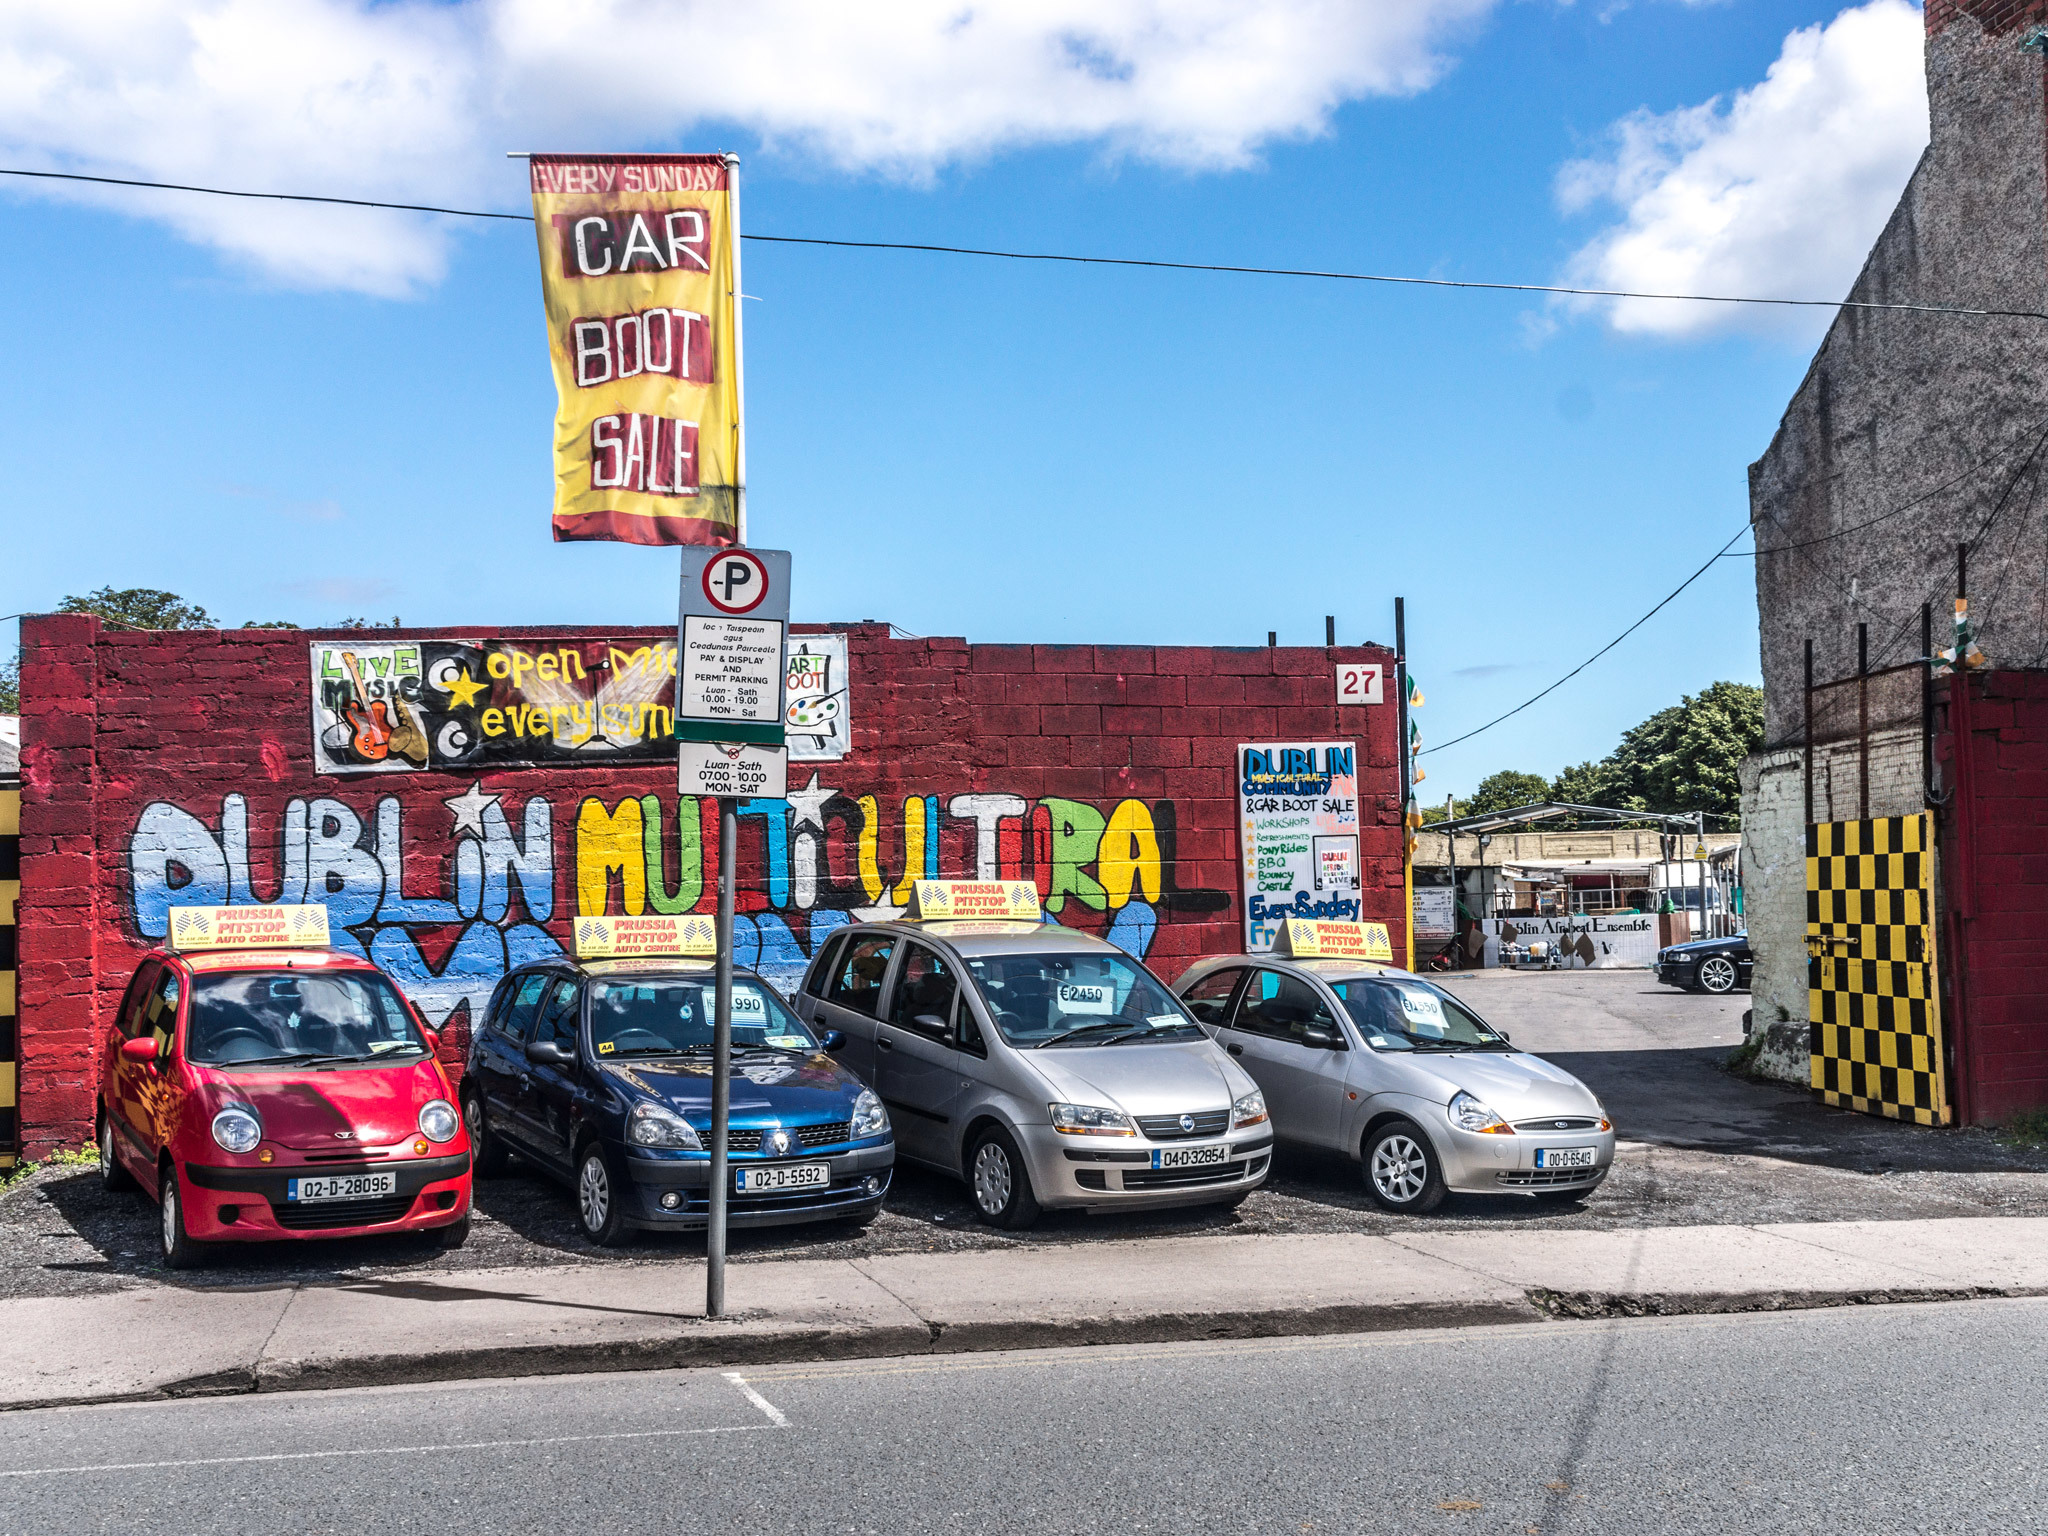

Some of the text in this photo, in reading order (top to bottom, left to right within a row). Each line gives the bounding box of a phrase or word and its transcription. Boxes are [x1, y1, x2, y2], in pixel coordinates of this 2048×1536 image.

[533, 165, 718, 193] EVERY SUNDAY
[575, 211, 710, 275] CAR
[575, 308, 702, 387] BOOT
[593, 412, 700, 494] SALE
[724, 561, 751, 601] P
[700, 654, 716, 662] PAY
[729, 656, 764, 664] DISPLAY
[487, 648, 587, 688] open
[723, 665, 742, 673] AND
[695, 673, 768, 684] PERMIT PARKING
[786, 672, 823, 690] OOT
[1344, 671, 1376, 694] 27
[737, 687, 757, 696] Sath
[701, 694, 725, 703] 10.00
[734, 696, 758, 705] 19.00
[742, 709, 757, 717] Sat
[481, 700, 593, 743] every
[705, 760, 729, 769] Luan
[737, 761, 762, 771] Sath
[1243, 747, 1353, 780] DUBLIN
[738, 773, 767, 782] 10.00
[705, 783, 732, 792] MON
[739, 784, 760, 793] SAT
[1283, 799, 1318, 812] BOOT
[1322, 798, 1355, 814] SALE
[1258, 857, 1287, 870] BBQ
[951, 884, 1005, 895] PRUSSIA
[954, 896, 1006, 906] PITSTOP
[215, 908, 284, 921] PRUSSIA
[217, 922, 286, 934] PITSTOP
[614, 919, 677, 931] PRUSSIA
[1317, 923, 1362, 935] PRUSSIA
[1592, 917, 1652, 932] Ensemble
[215, 935, 246, 944] AUTO
[249, 934, 290, 943] CENTRE
[616, 932, 678, 944] PITSTOP
[1320, 935, 1363, 947] PITSTOP
[613, 945, 641, 953] AUTO
[644, 944, 681, 953] CENTRE
[1341, 947, 1367, 955] CENTRE
[756, 1168, 820, 1187] 02-D-5592
[304, 1176, 389, 1198] 02-D-28096
